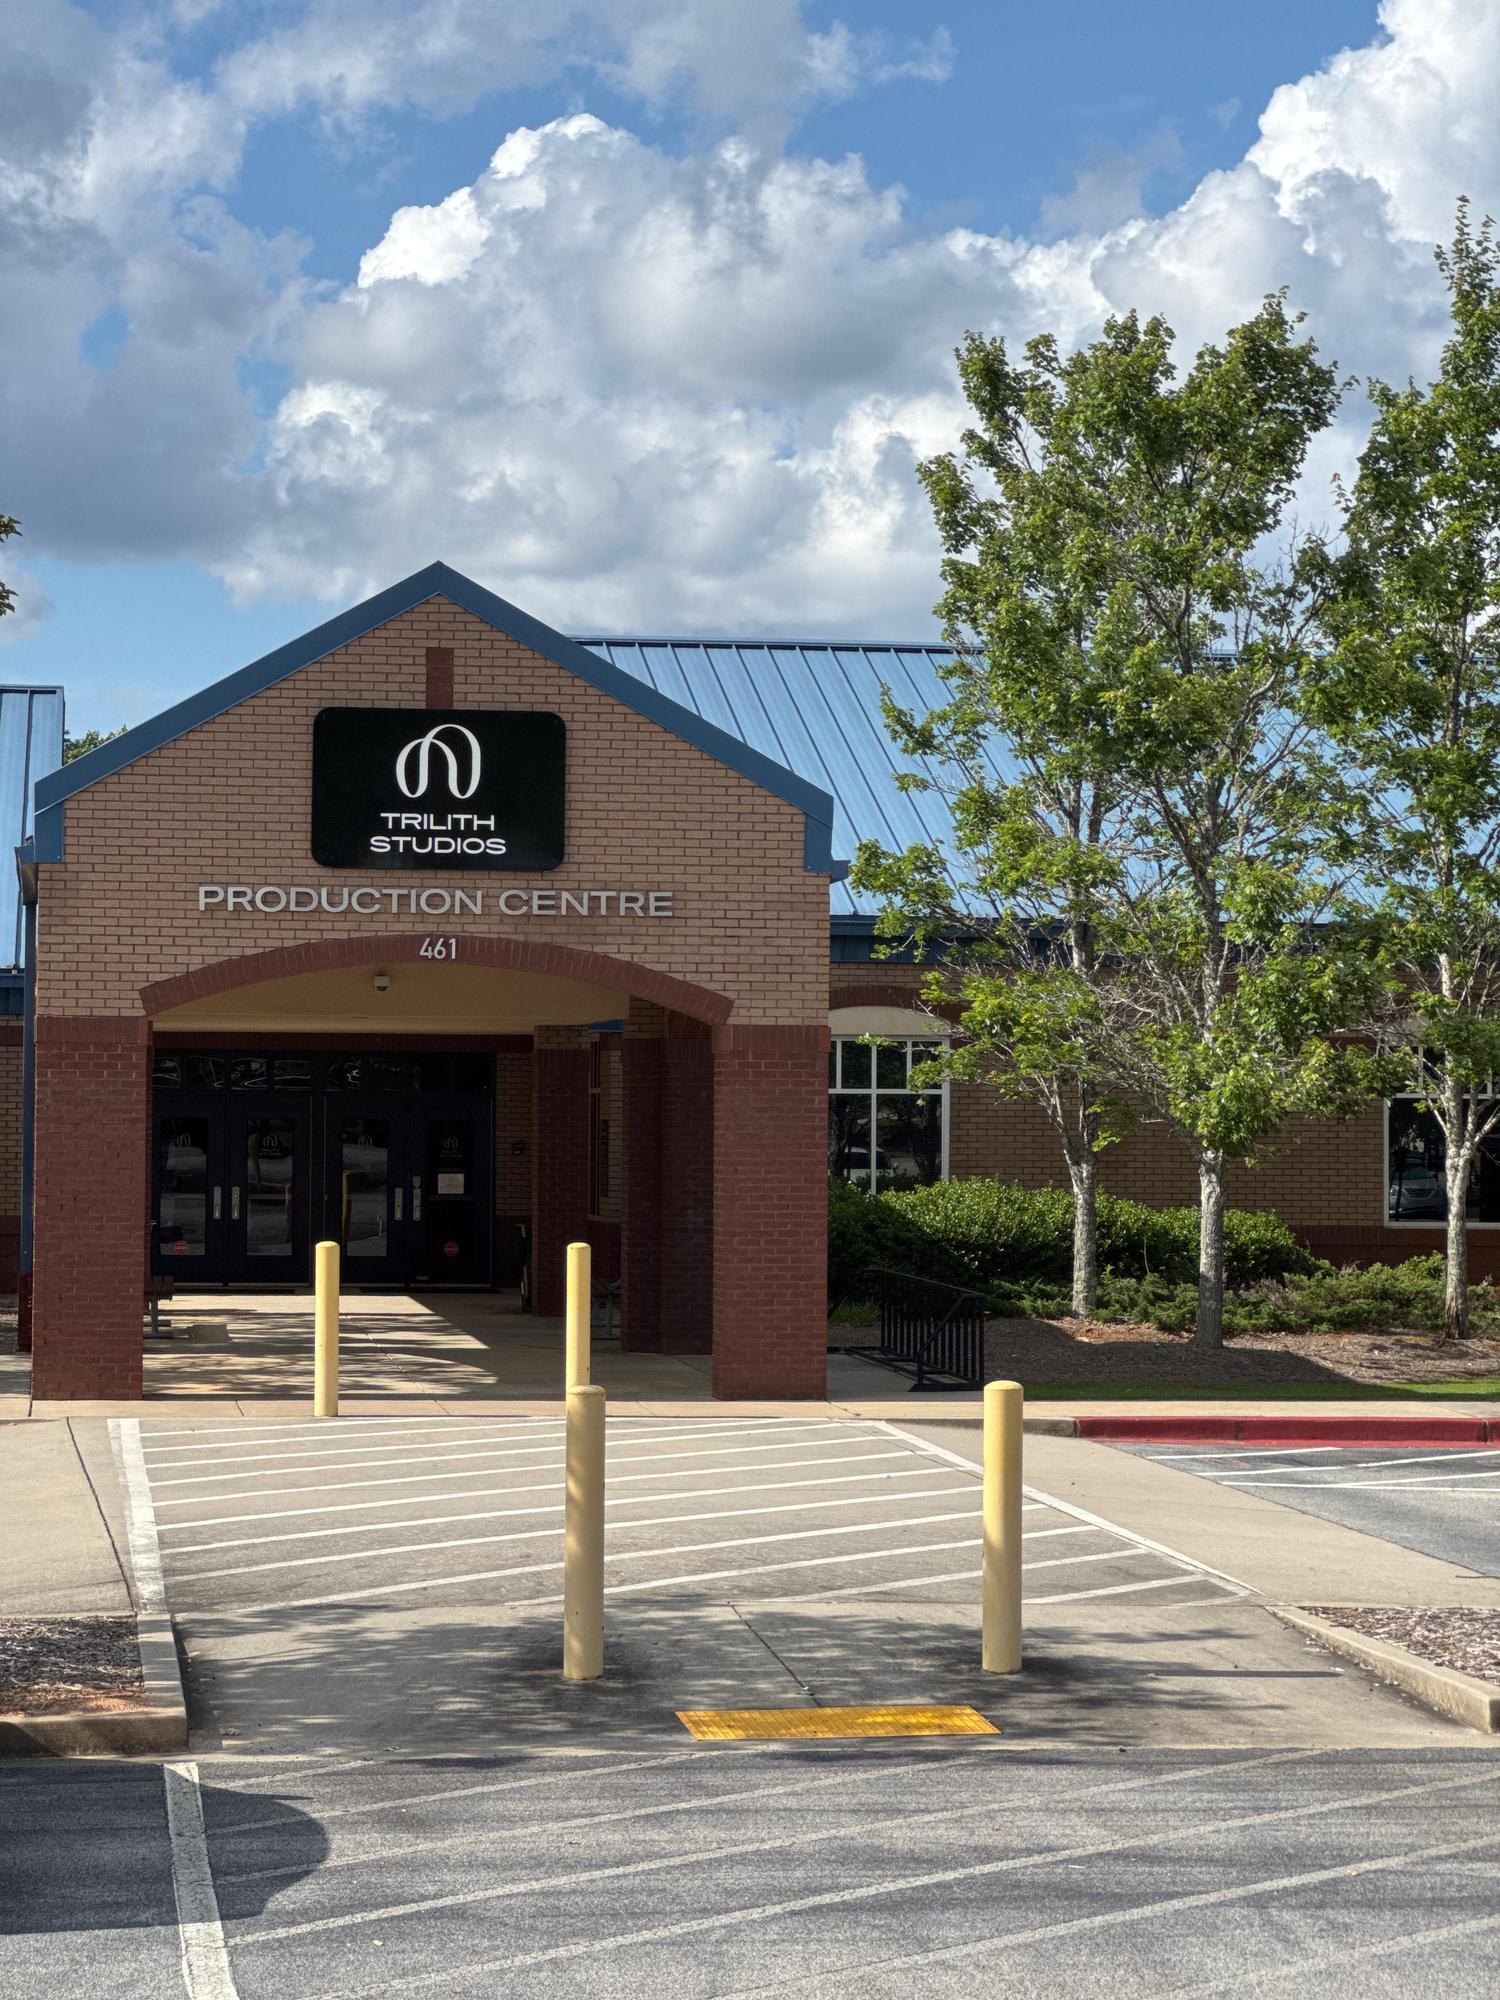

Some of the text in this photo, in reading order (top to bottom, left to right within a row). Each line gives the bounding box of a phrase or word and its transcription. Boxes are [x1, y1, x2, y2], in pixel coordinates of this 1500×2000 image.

[380, 812, 495, 831] TRILITH
[369, 835, 507, 855] STUDIOS
[198, 886, 674, 917] PRODUCTION CENTRE
[419, 937, 457, 960] 461
